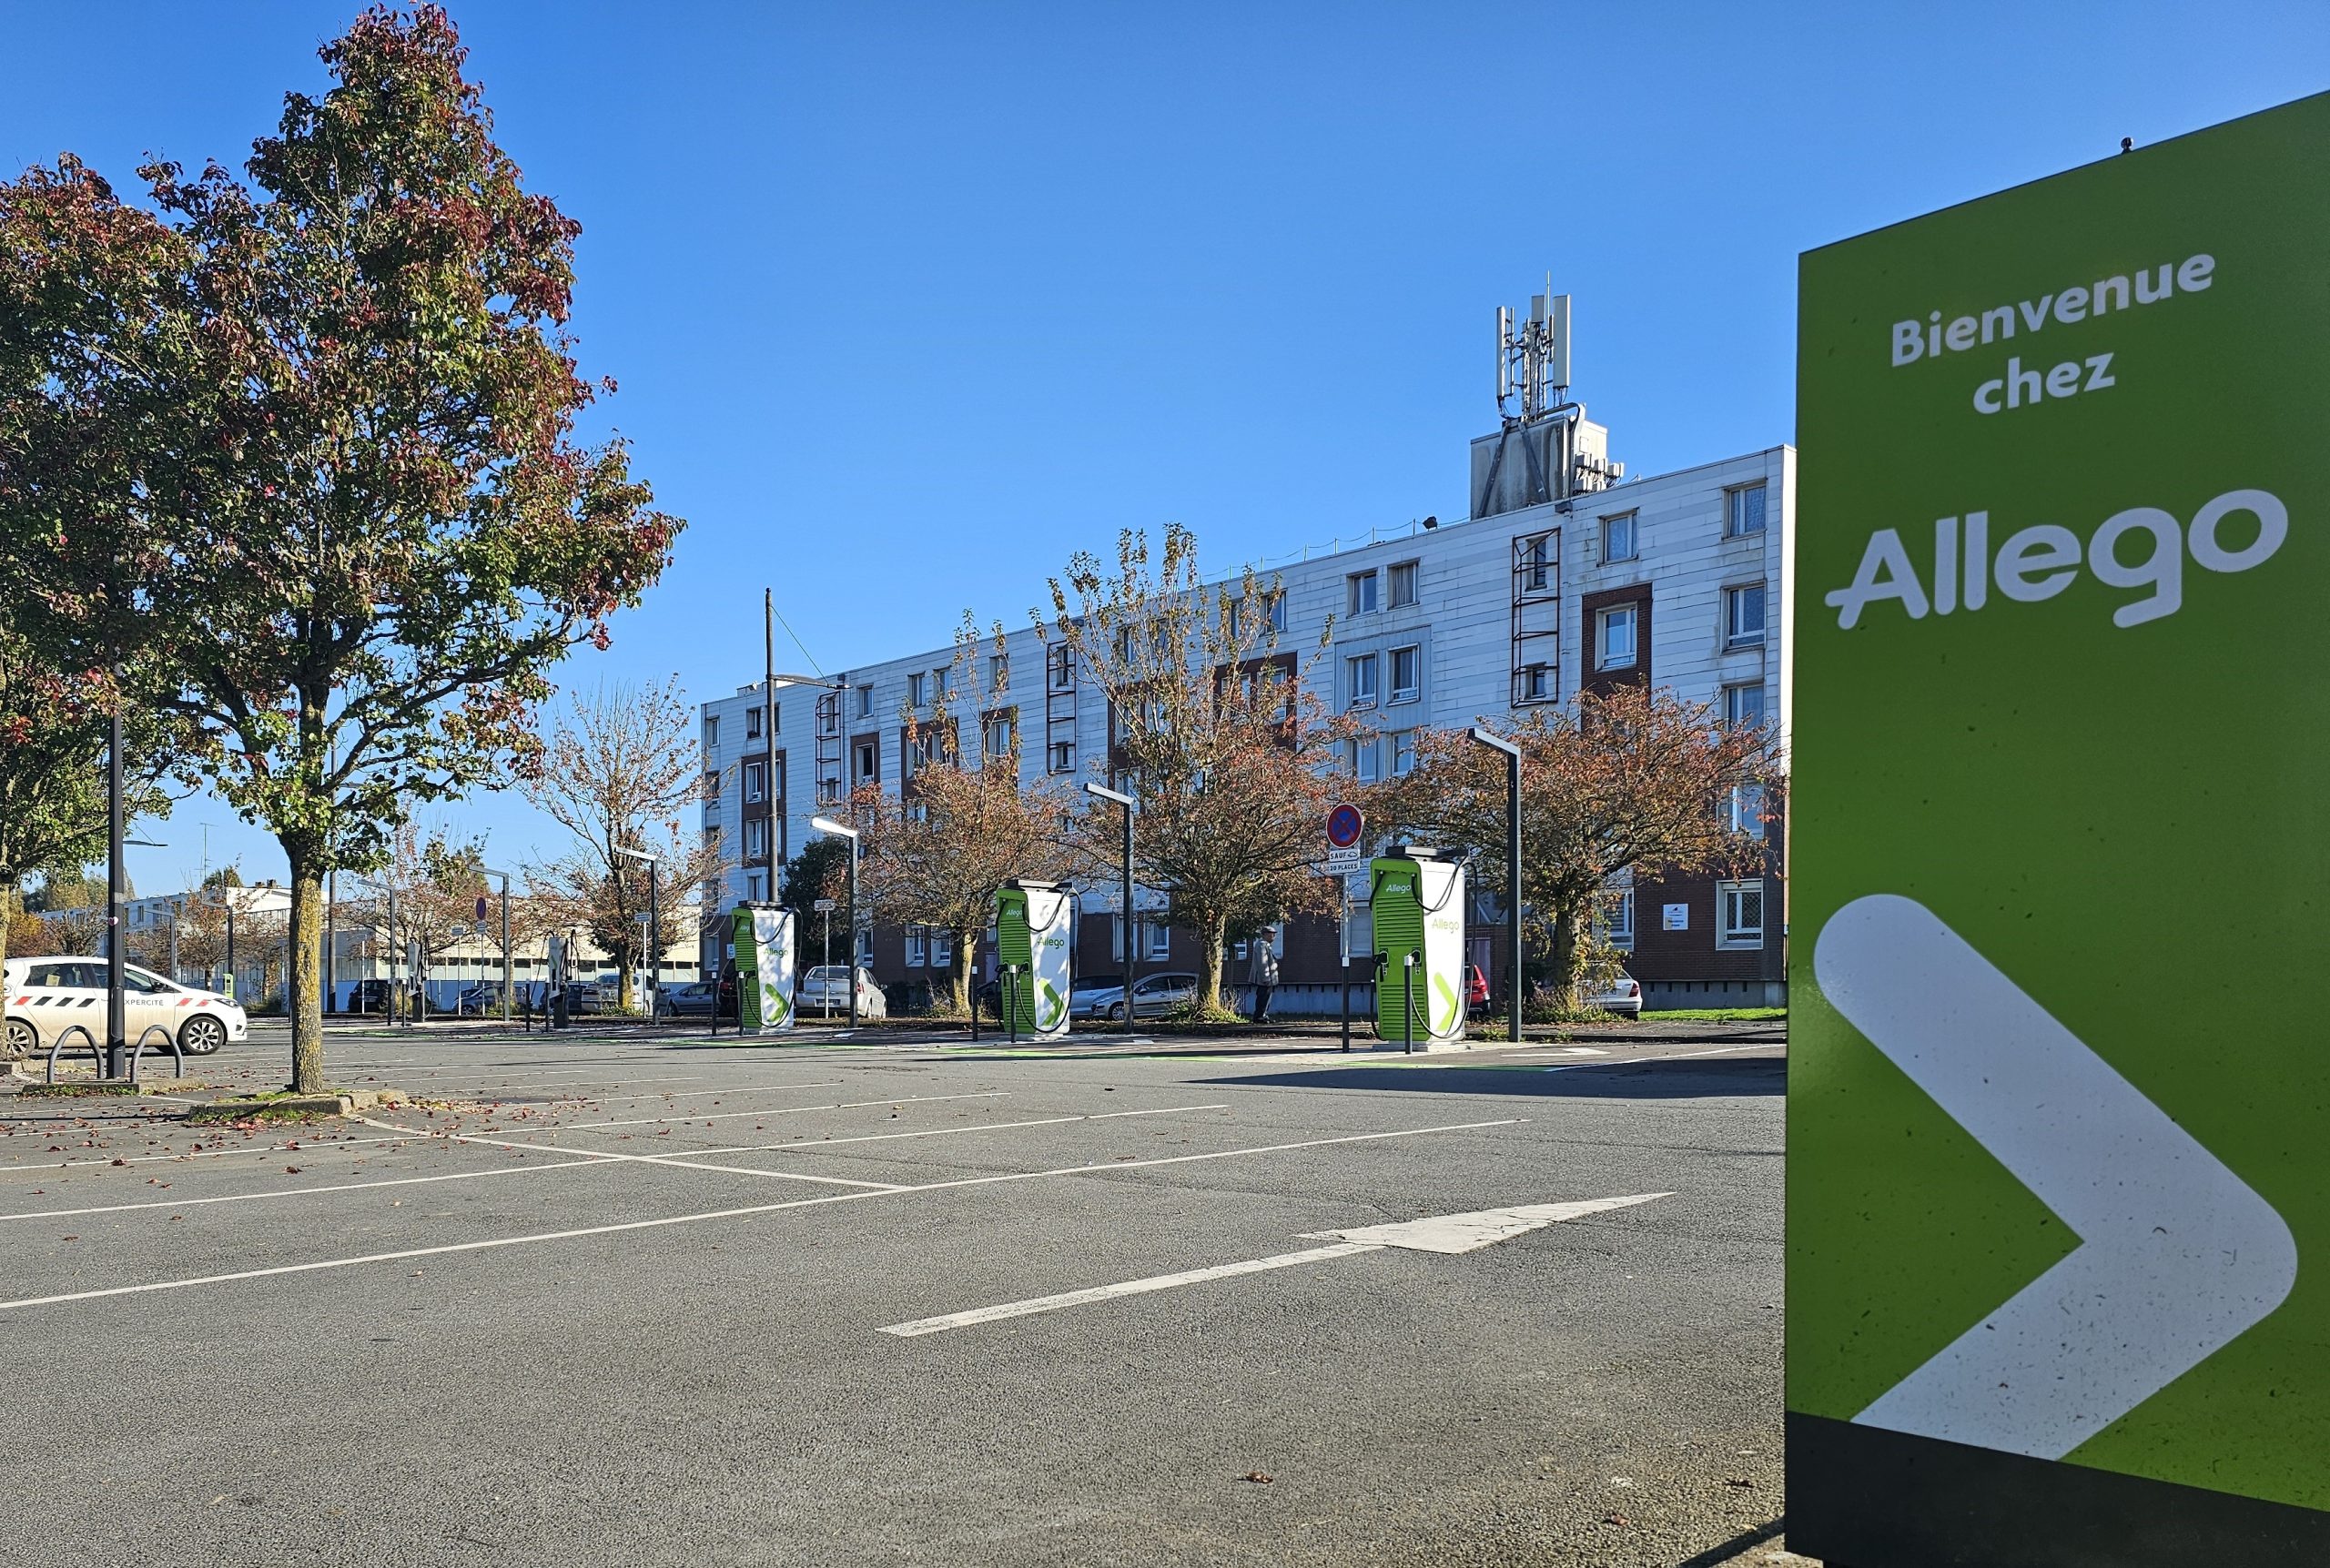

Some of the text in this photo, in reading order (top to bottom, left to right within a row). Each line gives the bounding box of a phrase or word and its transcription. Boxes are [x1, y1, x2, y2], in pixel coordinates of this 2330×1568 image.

[1892, 254, 2215, 367] Bienvenue
[1973, 352, 2115, 414] chez
[1825, 489, 2288, 630] Allego
[1386, 884, 1412, 894] Allego
[1432, 917, 1460, 934] Allego
[1038, 936, 1065, 949] Allego
[763, 947, 789, 959] Allego
